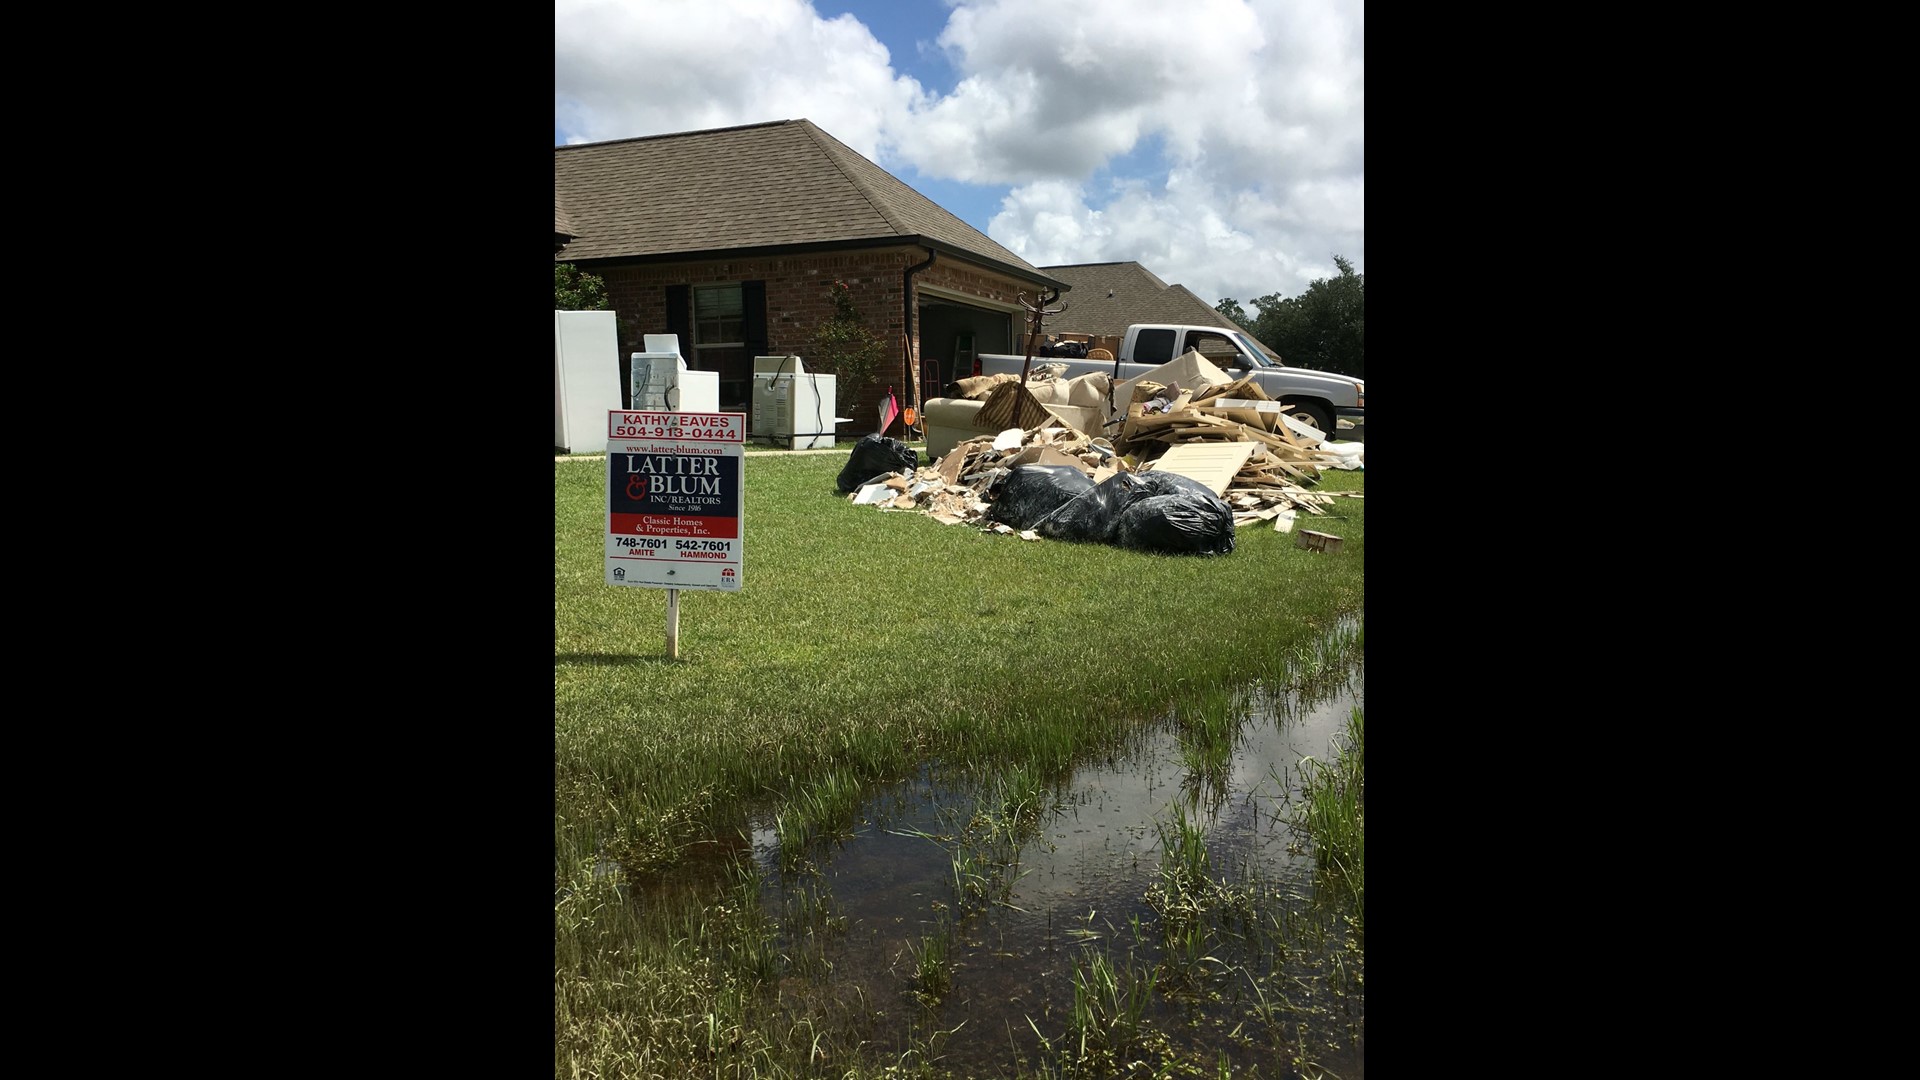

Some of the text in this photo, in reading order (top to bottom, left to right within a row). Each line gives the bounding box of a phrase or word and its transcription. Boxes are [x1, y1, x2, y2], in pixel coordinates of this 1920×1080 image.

[623, 414, 729, 428] KATHY EAVES
[616, 426, 736, 439] 504-913-0444
[626, 444, 723, 455] www.latter-blum.com
[627, 455, 720, 476] LATTER
[625, 474, 722, 500] & BLUM
[650, 495, 721, 505] INC/REALTORS
[668, 504, 686, 512] Since
[642, 515, 703, 526] Classic Homes
[635, 524, 711, 535] & Properties, Inc.
[615, 537, 667, 549] 748-7601
[675, 540, 731, 551] 542-7601
[629, 548, 655, 556] AMITE
[680, 551, 727, 559] HAMMOND
